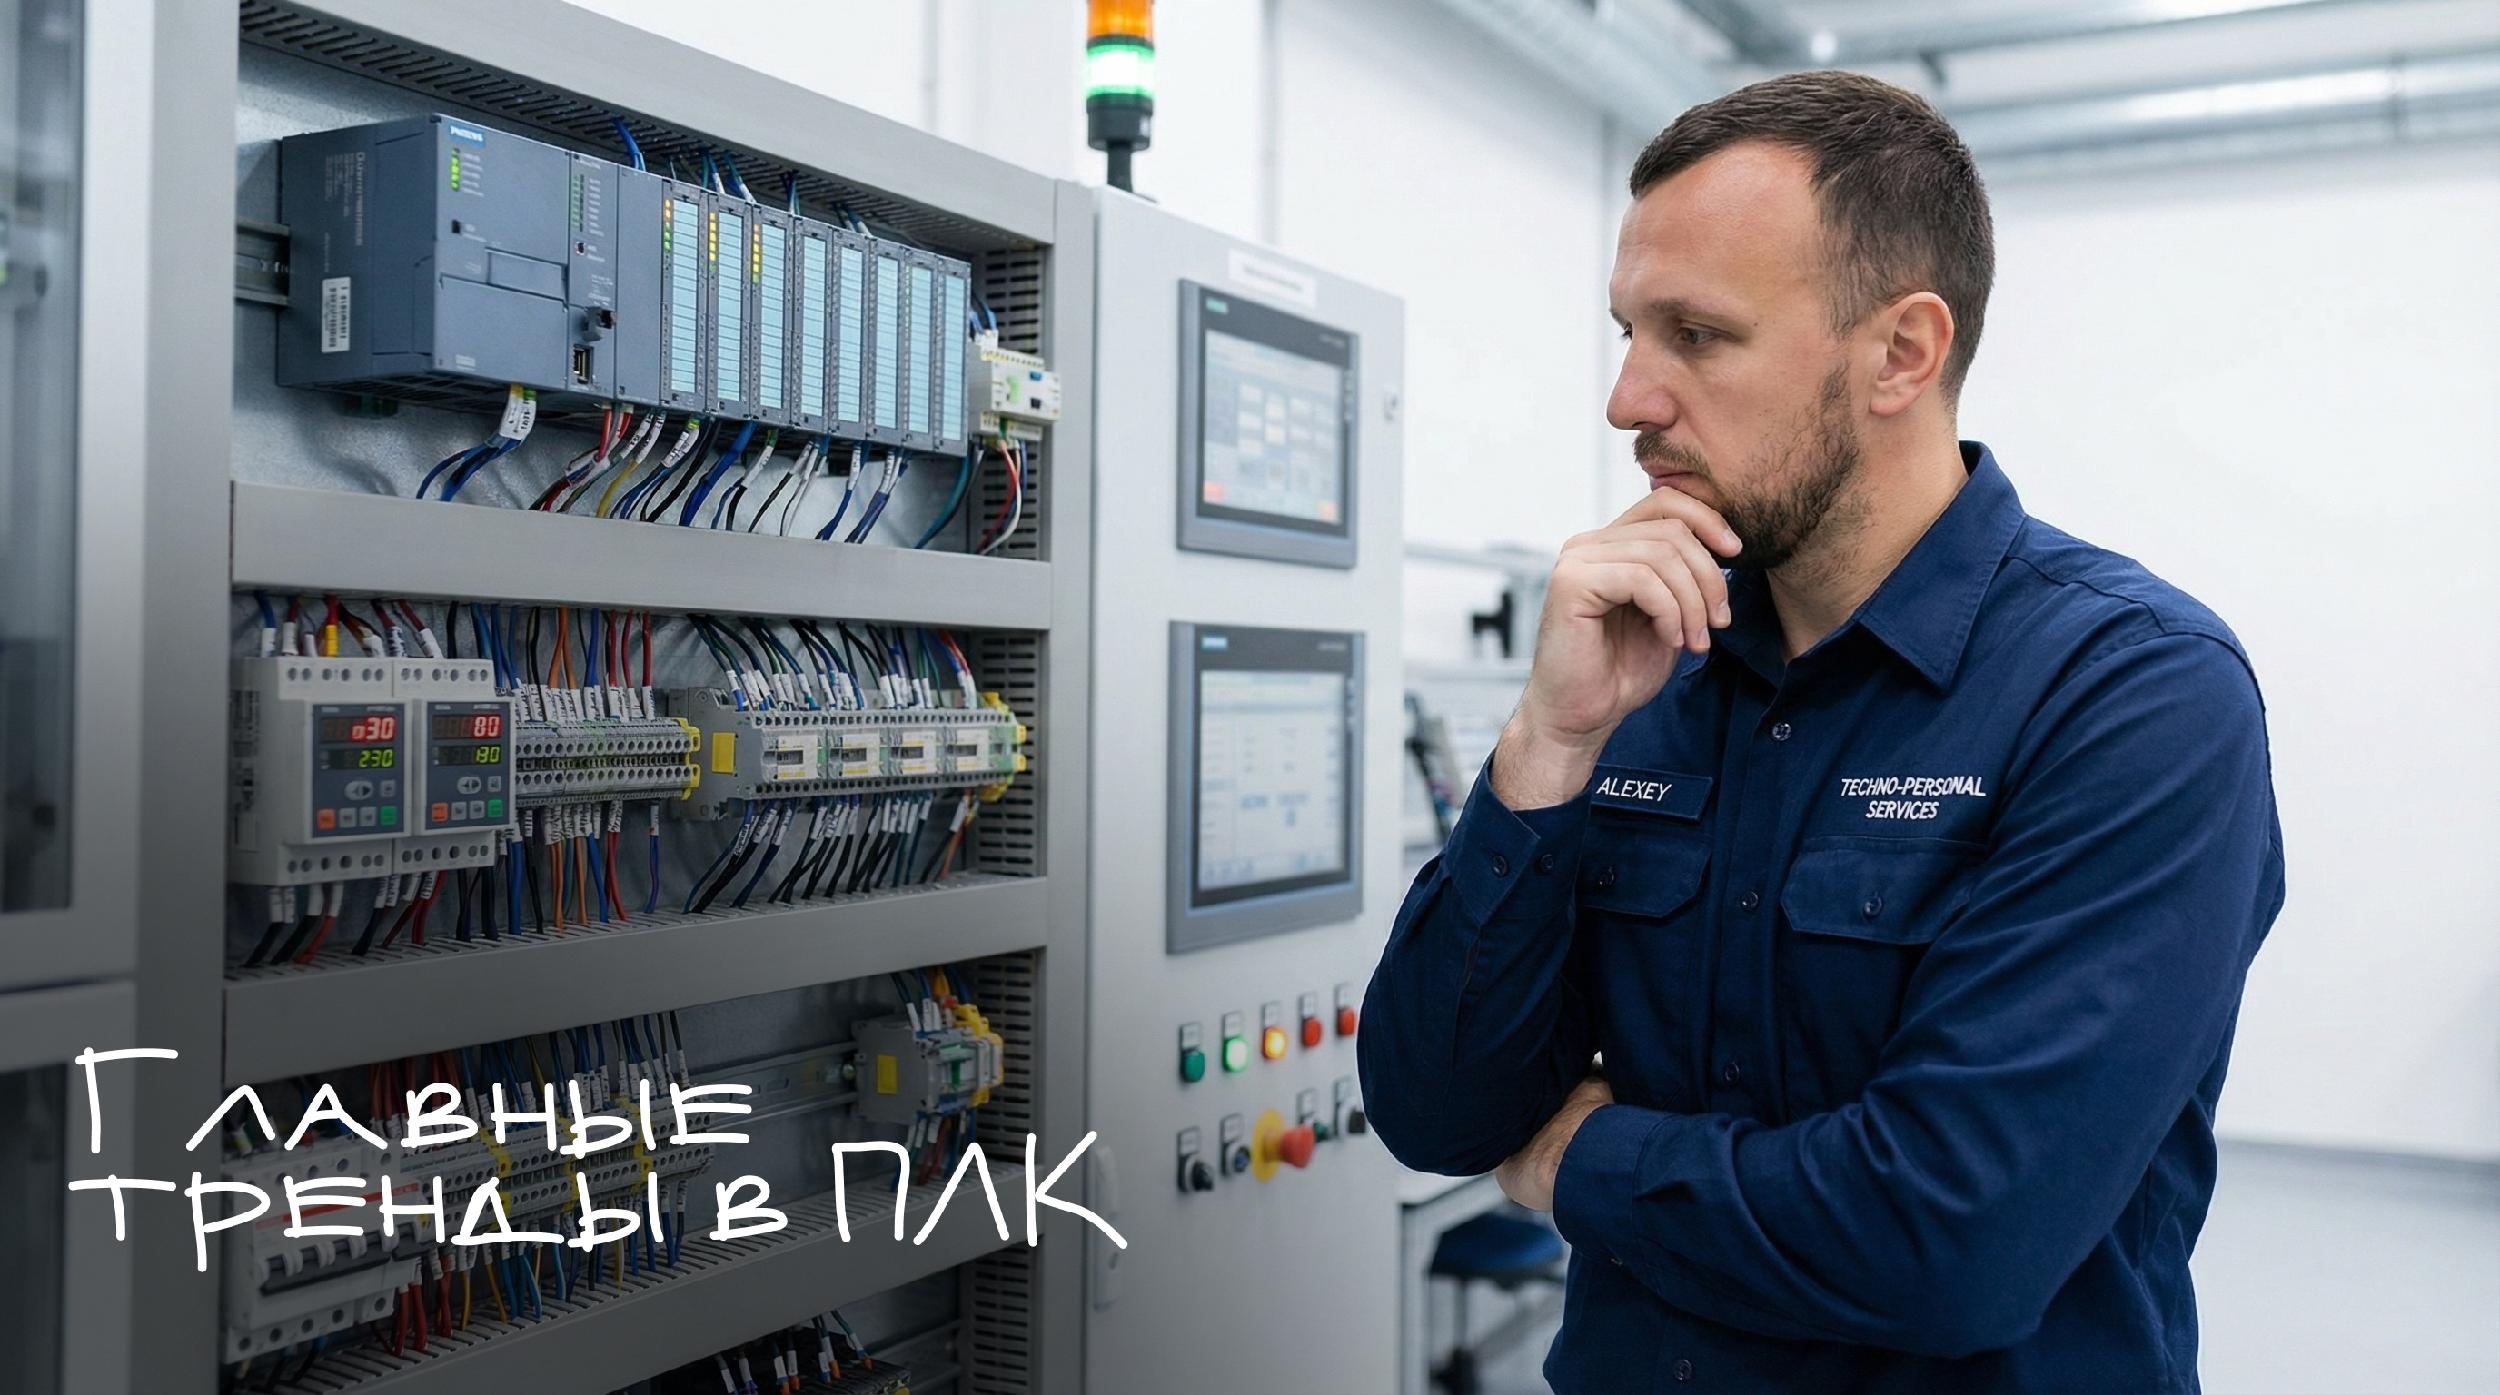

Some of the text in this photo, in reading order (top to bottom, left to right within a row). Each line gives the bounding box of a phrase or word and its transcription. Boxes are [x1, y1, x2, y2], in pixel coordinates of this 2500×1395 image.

[359, 748, 394, 768] 230
[1596, 776, 1673, 802] ALEXEY
[1840, 776, 1987, 798] TECHNO-PERSONAL
[1865, 800, 1941, 821] SERVICES
